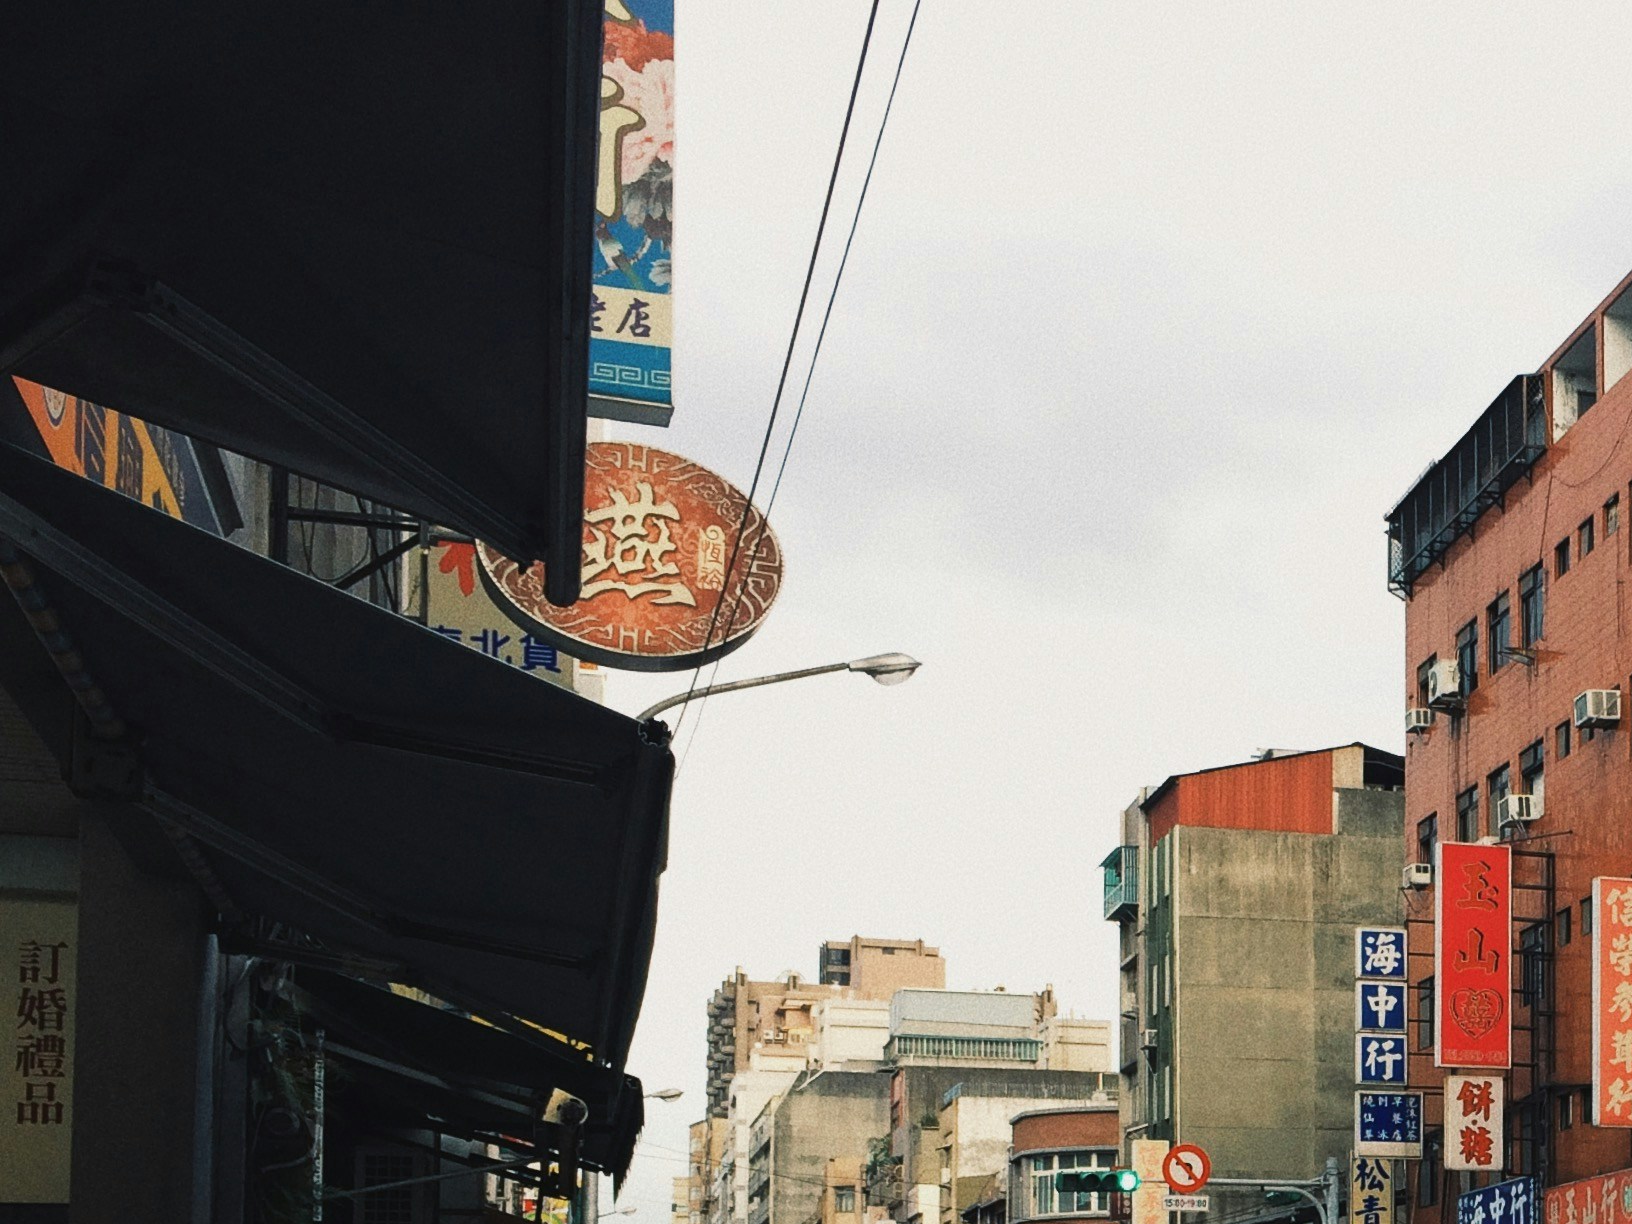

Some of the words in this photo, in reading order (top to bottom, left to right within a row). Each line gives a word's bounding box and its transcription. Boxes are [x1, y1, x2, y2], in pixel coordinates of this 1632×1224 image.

[1453, 860, 1500, 974] 玉山
[15, 939, 69, 1126] 訂婚禮品
[1364, 933, 1402, 1081] 海中行
